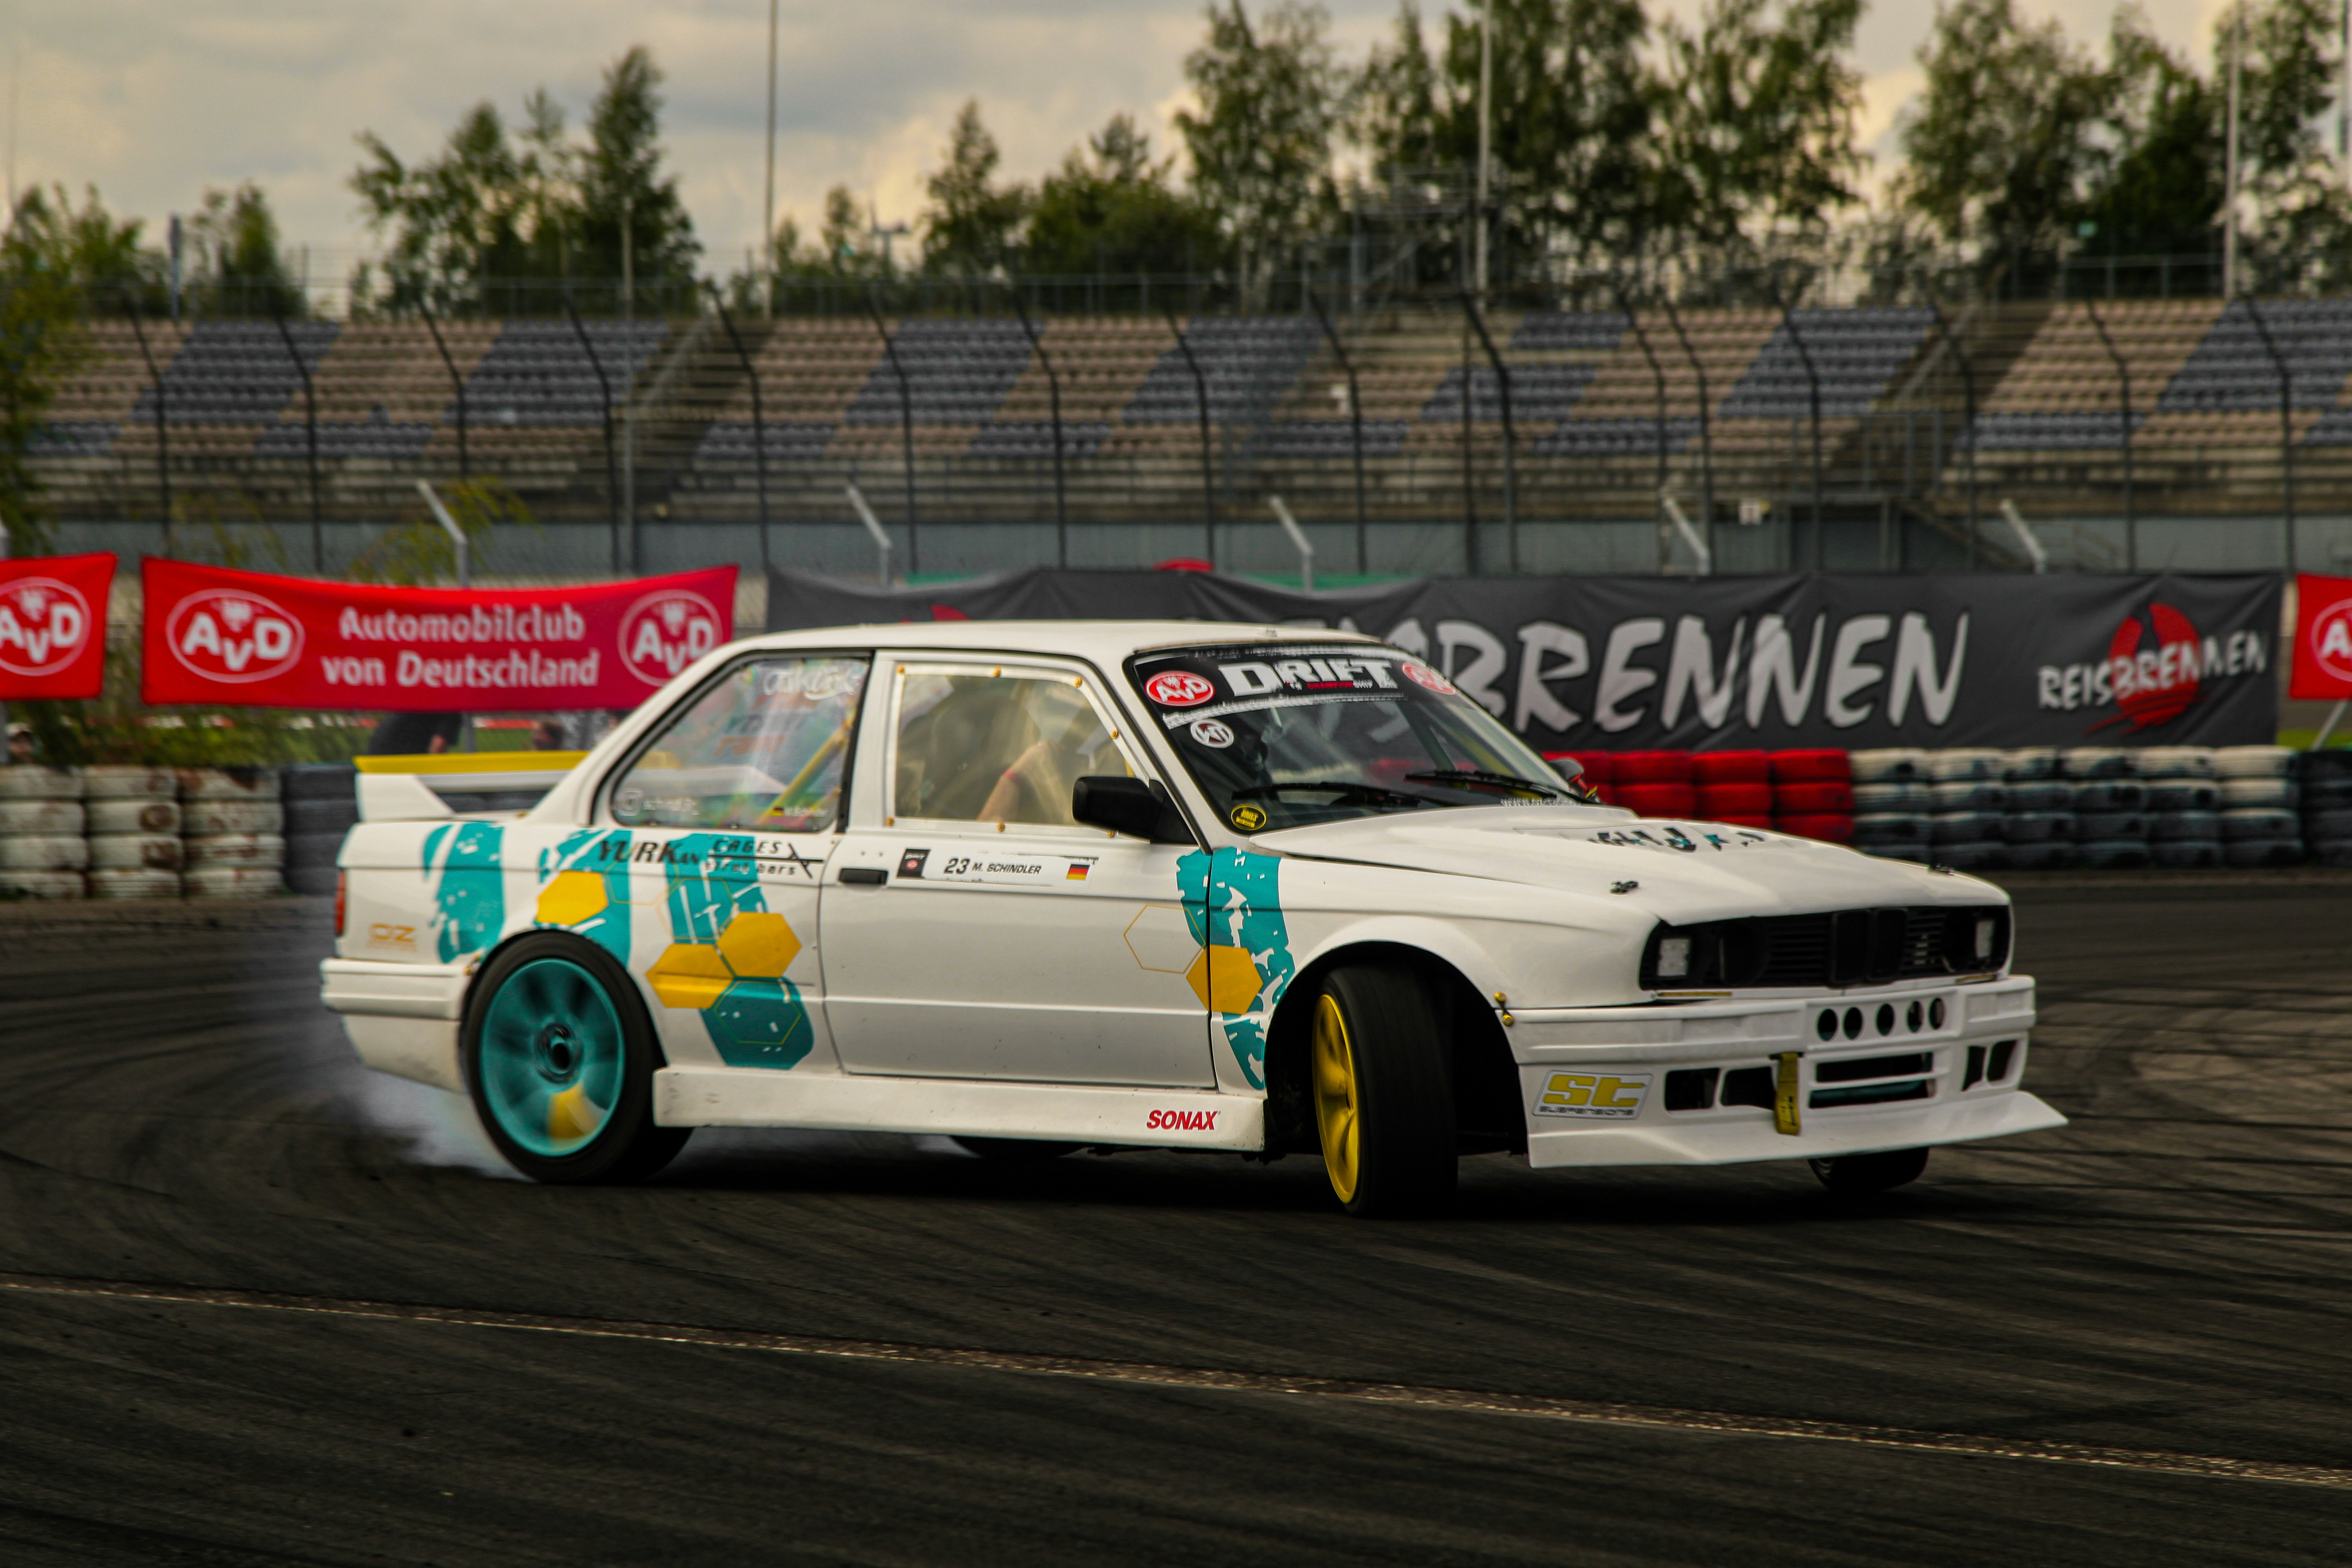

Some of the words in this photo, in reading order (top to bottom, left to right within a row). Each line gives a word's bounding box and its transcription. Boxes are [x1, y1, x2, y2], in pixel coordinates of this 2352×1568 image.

[339, 603, 586, 642] Automobilclub
[320, 655, 386, 686] von
[396, 647, 600, 688] Deutschland
[1218, 658, 1398, 696] DRIFT
[2038, 630, 2267, 710] REISBRENNEN
[944, 857, 970, 875] 23
[972, 863, 983, 872] M.
[987, 863, 1042, 875] SCHINDLER
[1147, 1109, 1218, 1131] SONAX
